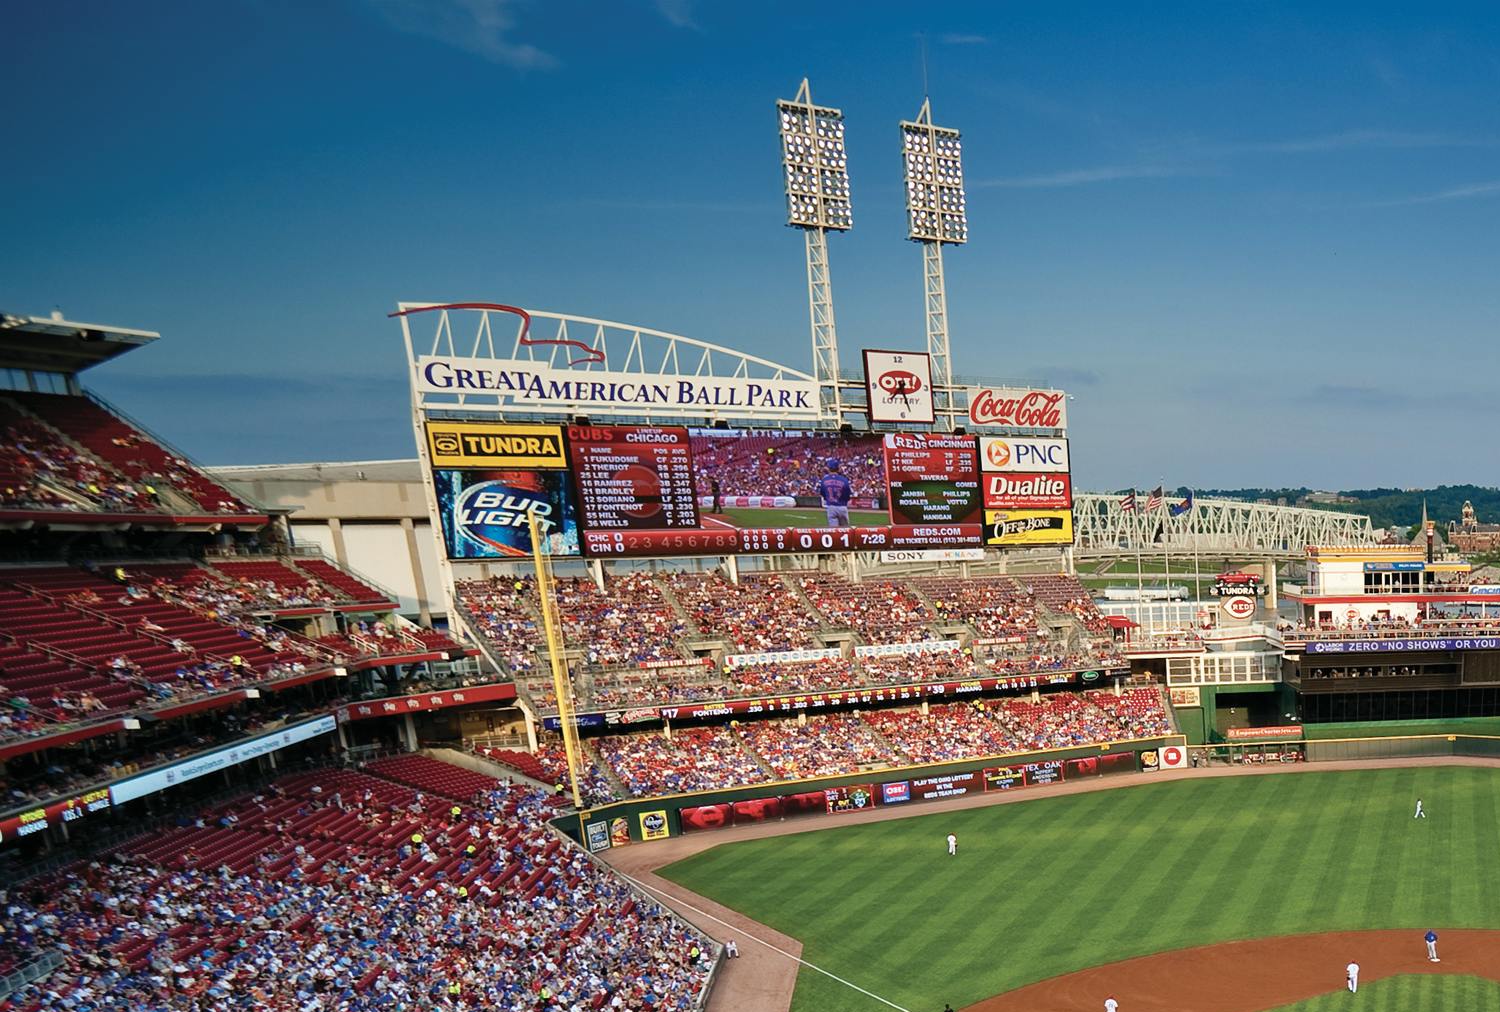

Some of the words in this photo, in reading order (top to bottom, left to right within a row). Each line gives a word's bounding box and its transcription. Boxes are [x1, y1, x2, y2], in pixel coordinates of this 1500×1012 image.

[893, 356, 904, 364] 12
[424, 362, 532, 390] GREAT
[523, 375, 670, 402] AMERICAN
[676, 380, 742, 406] BALL
[745, 384, 810, 408] PARK
[971, 390, 1064, 427] Coca-Cola
[567, 428, 614, 440] CUBS
[626, 434, 678, 443] CHICAGO
[464, 436, 558, 455] TUNDRA
[928, 440, 976, 449] CINCINNATI
[1014, 444, 1063, 465] PNC
[990, 475, 1065, 496] Dualite
[474, 492, 552, 516] BUD
[588, 534, 609, 542] CHC
[614, 532, 623, 542] 0
[913, 528, 961, 536] REDS.COM
[629, 538, 638, 549] 2
[643, 537, 652, 548] 3
[661, 537, 670, 548] 4
[674, 536, 683, 547] 5
[688, 536, 697, 547] 6
[702, 536, 712, 546] 7
[715, 535, 724, 546] 8
[729, 535, 738, 546] 9
[800, 534, 813, 548] 0
[821, 534, 833, 548] 0
[840, 534, 849, 547] 1
[861, 534, 886, 544] 7:28
[591, 544, 612, 552] CIN
[615, 542, 625, 552] 0
[887, 552, 925, 560] SONY
[1221, 587, 1254, 595] TUNDRA
[1232, 603, 1254, 611] REDS
[1349, 642, 1378, 651] ZERO
[1383, 642, 1404, 650] "NO
[1407, 640, 1452, 650] SHOWS"
[1456, 640, 1471, 649] OR
[1474, 639, 1496, 649] YOU
[692, 707, 734, 717] FONTENOT
[952, 774, 974, 782] LOTTERY
